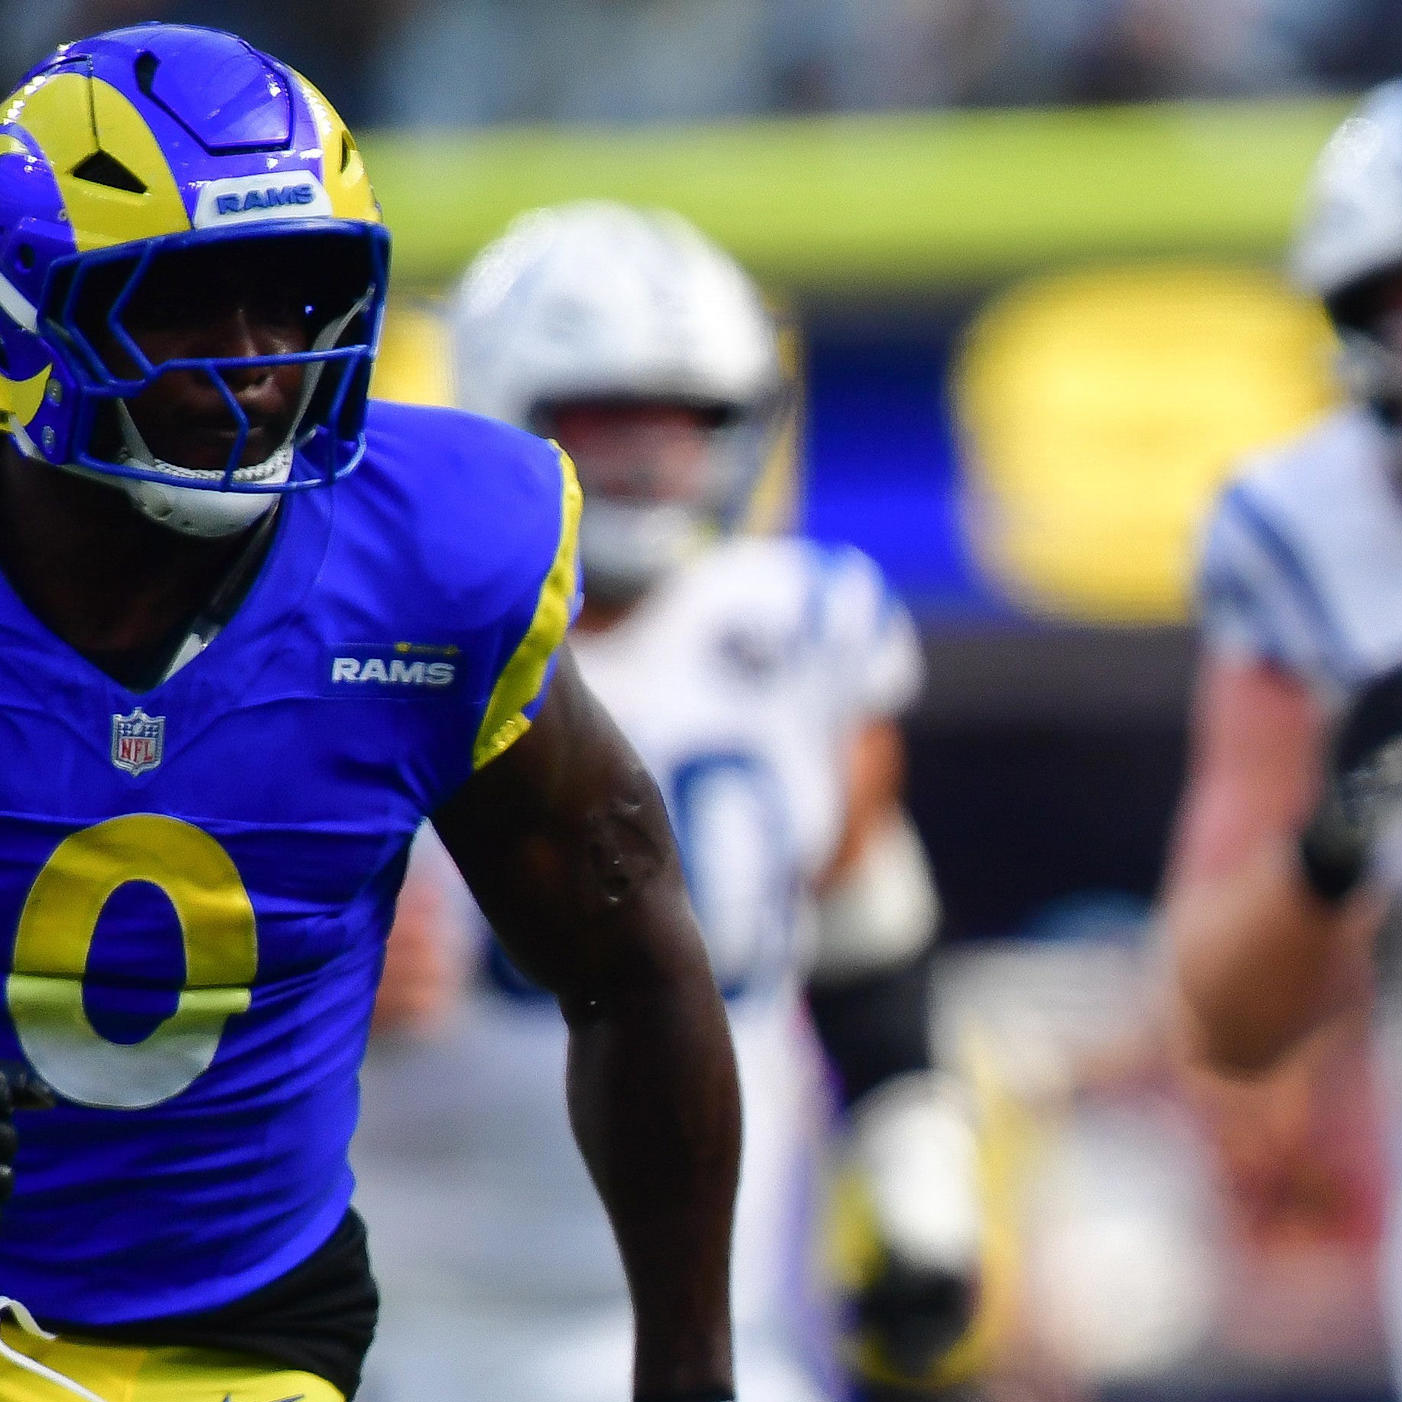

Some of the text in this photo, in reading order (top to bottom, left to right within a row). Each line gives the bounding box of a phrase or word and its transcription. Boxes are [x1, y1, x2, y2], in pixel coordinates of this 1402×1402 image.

[215, 183, 315, 216] RAMS
[331, 656, 456, 685] RAMS
[119, 737, 156, 763] NFL
[6, 812, 259, 1110] 0
